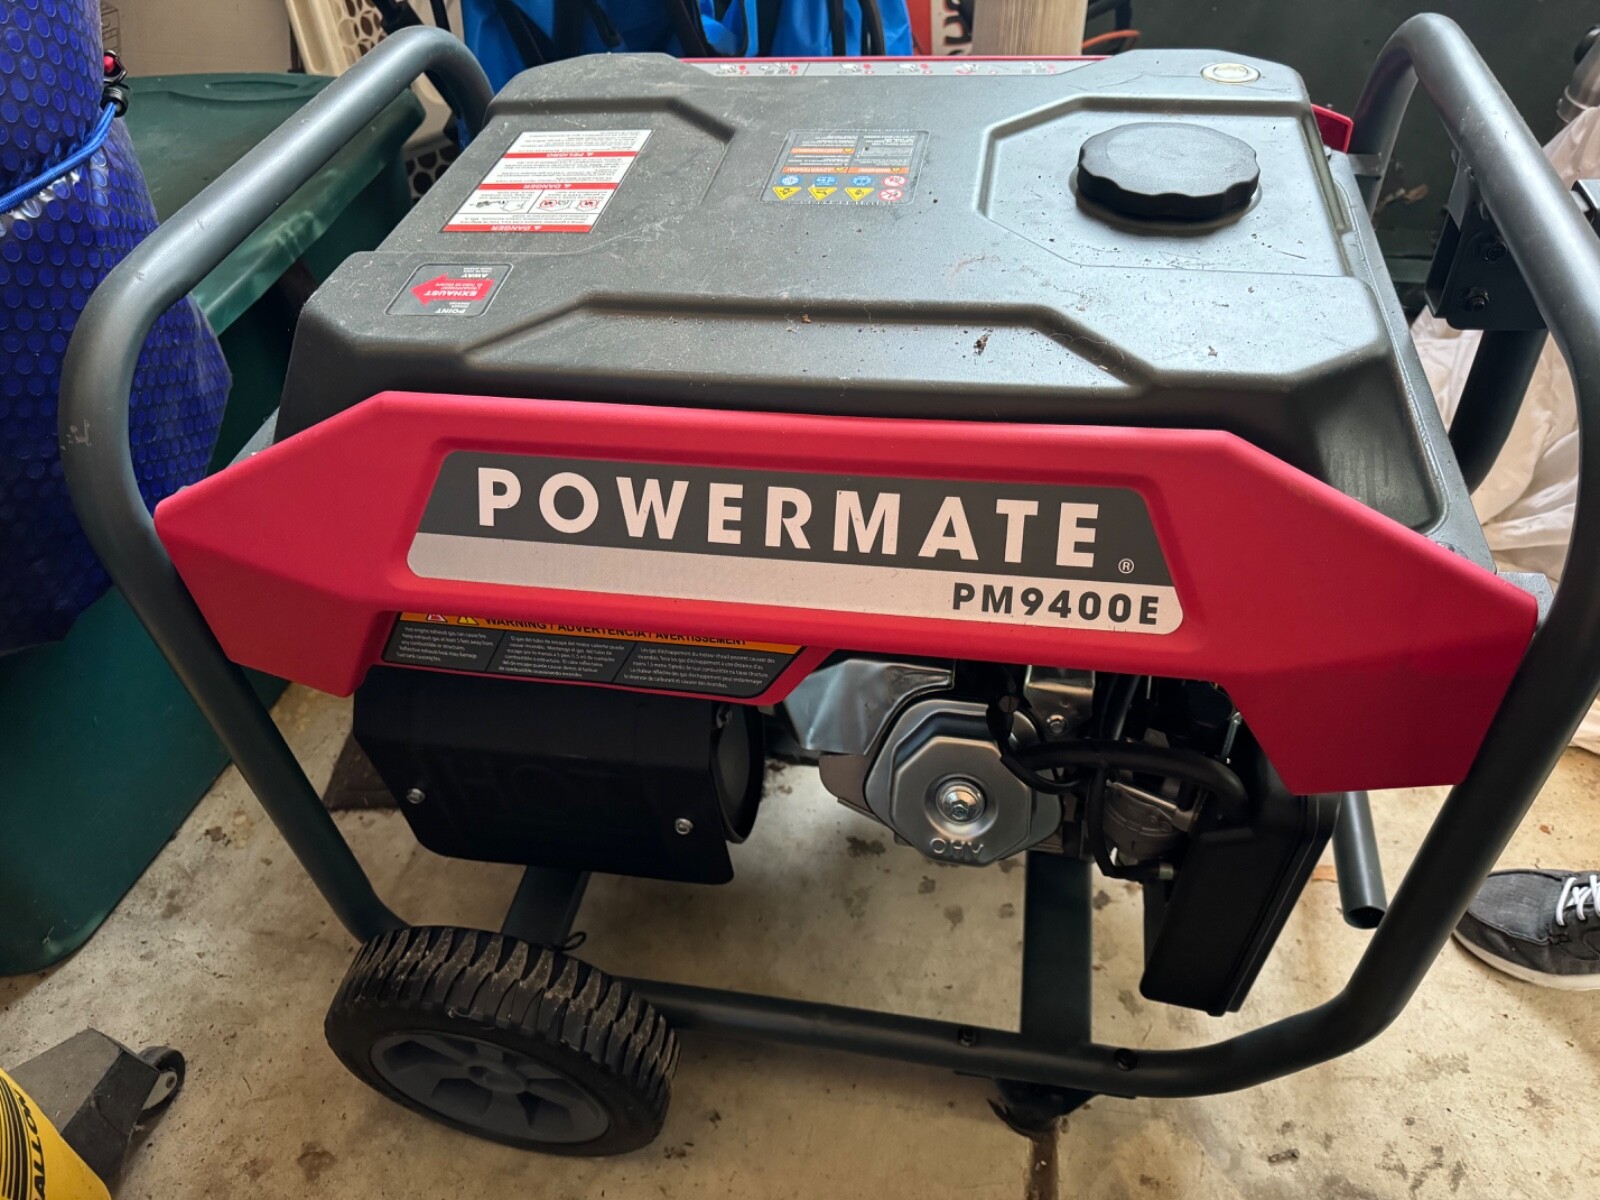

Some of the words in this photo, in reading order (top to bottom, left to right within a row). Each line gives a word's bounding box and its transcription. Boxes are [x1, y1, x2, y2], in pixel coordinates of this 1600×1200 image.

[477, 466, 1099, 569] POWERMATE
[952, 582, 1159, 625] PM9400E
[929, 837, 984, 854] OHV
